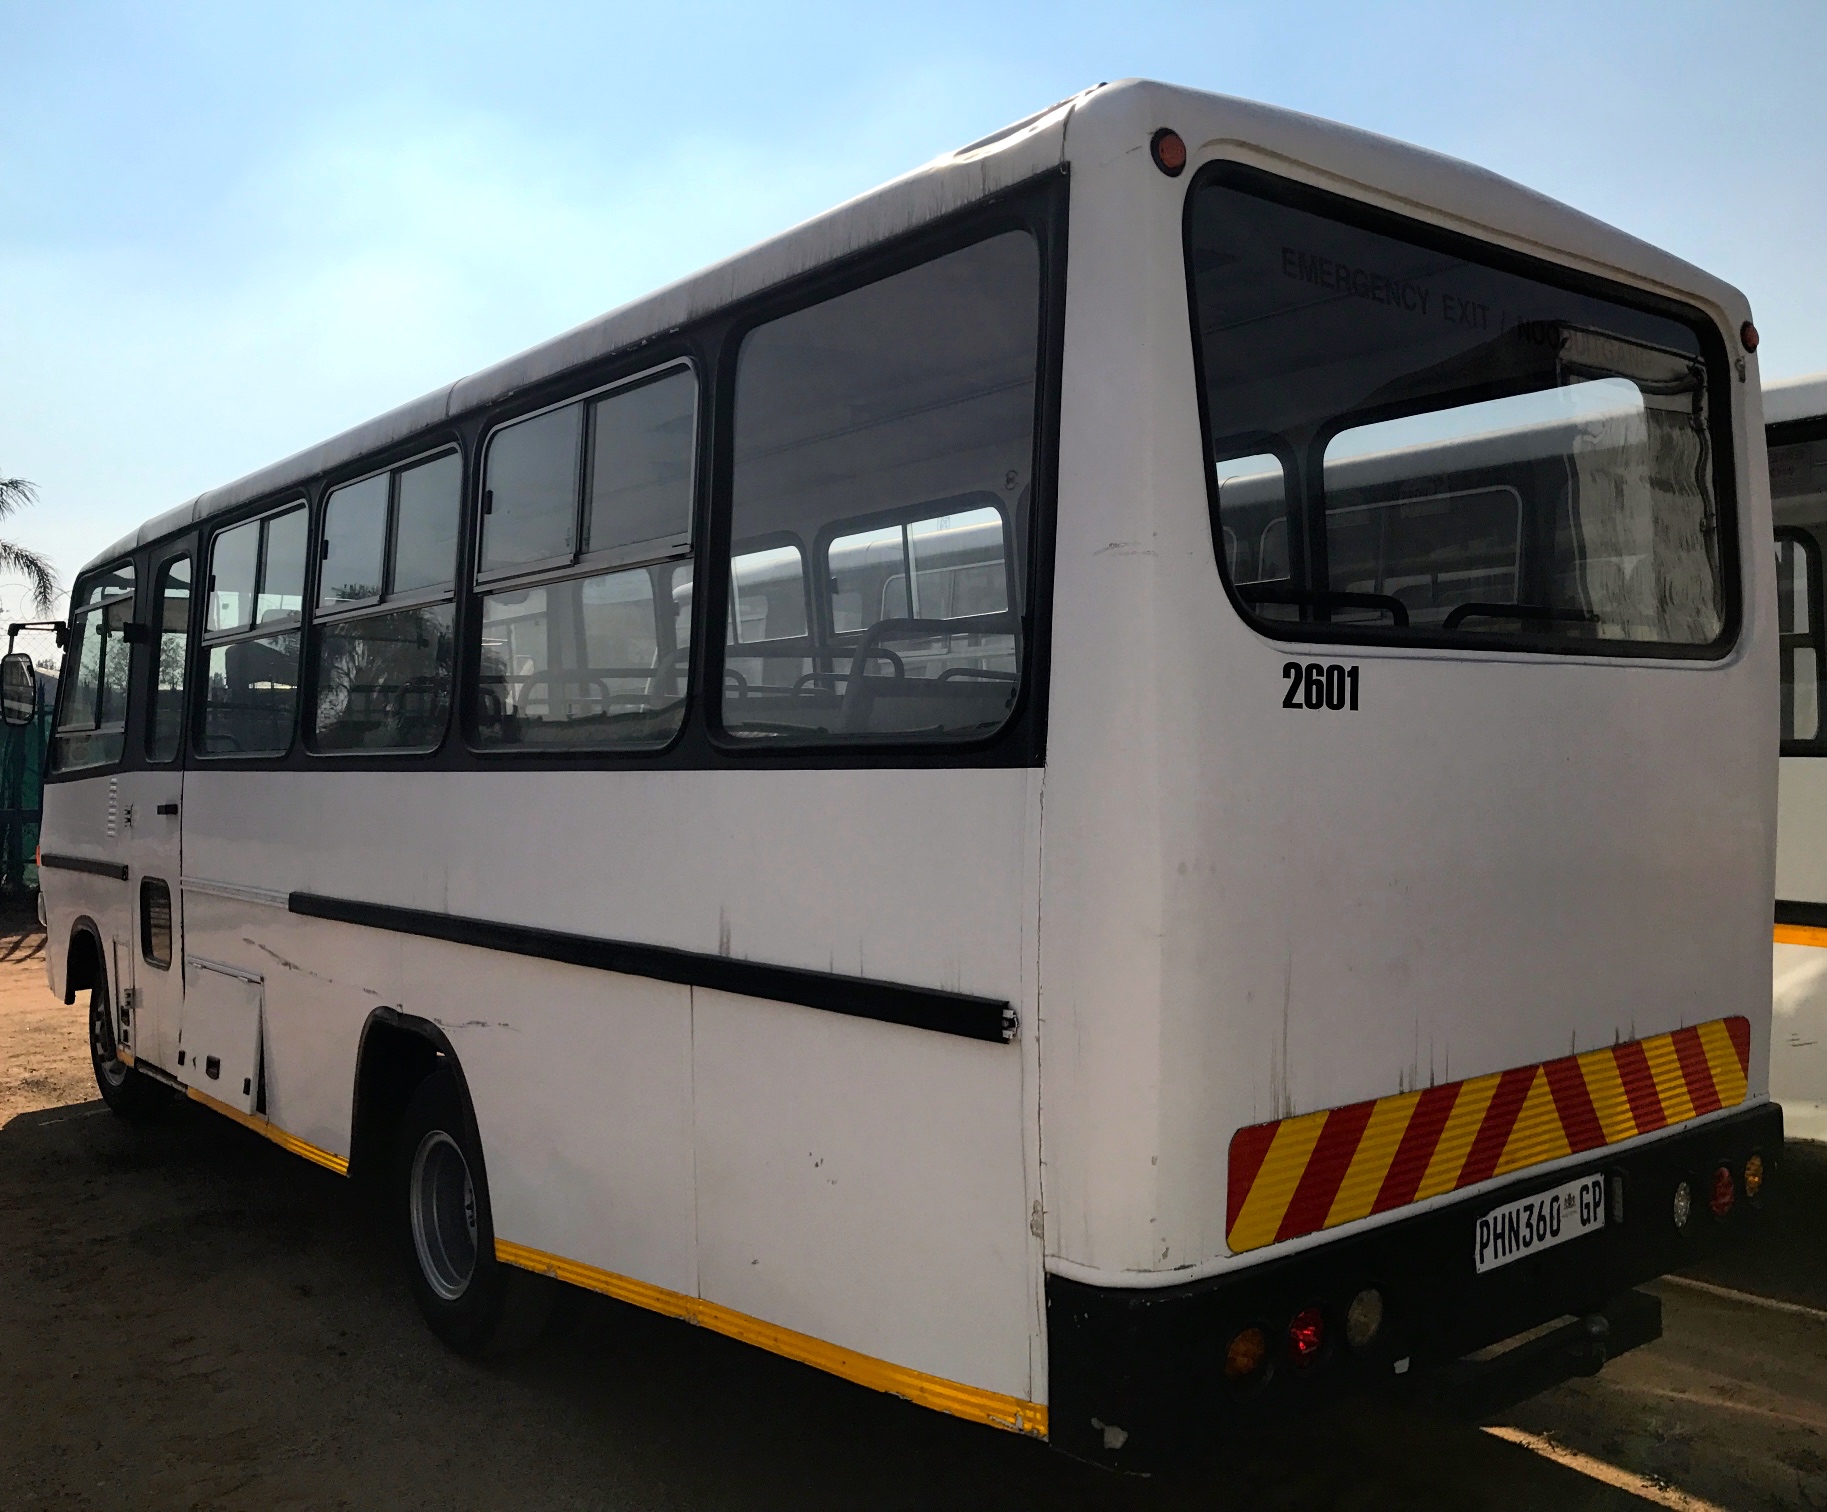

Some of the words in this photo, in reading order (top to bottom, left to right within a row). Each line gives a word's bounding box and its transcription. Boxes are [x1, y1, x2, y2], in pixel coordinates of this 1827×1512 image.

[1281, 247, 1429, 315] EMERGENCY
[1441, 293, 1490, 330] EXIT
[1282, 661, 1360, 711] 2601
[1479, 1194, 1561, 1265] PHN360
[1579, 1180, 1602, 1227] GP
